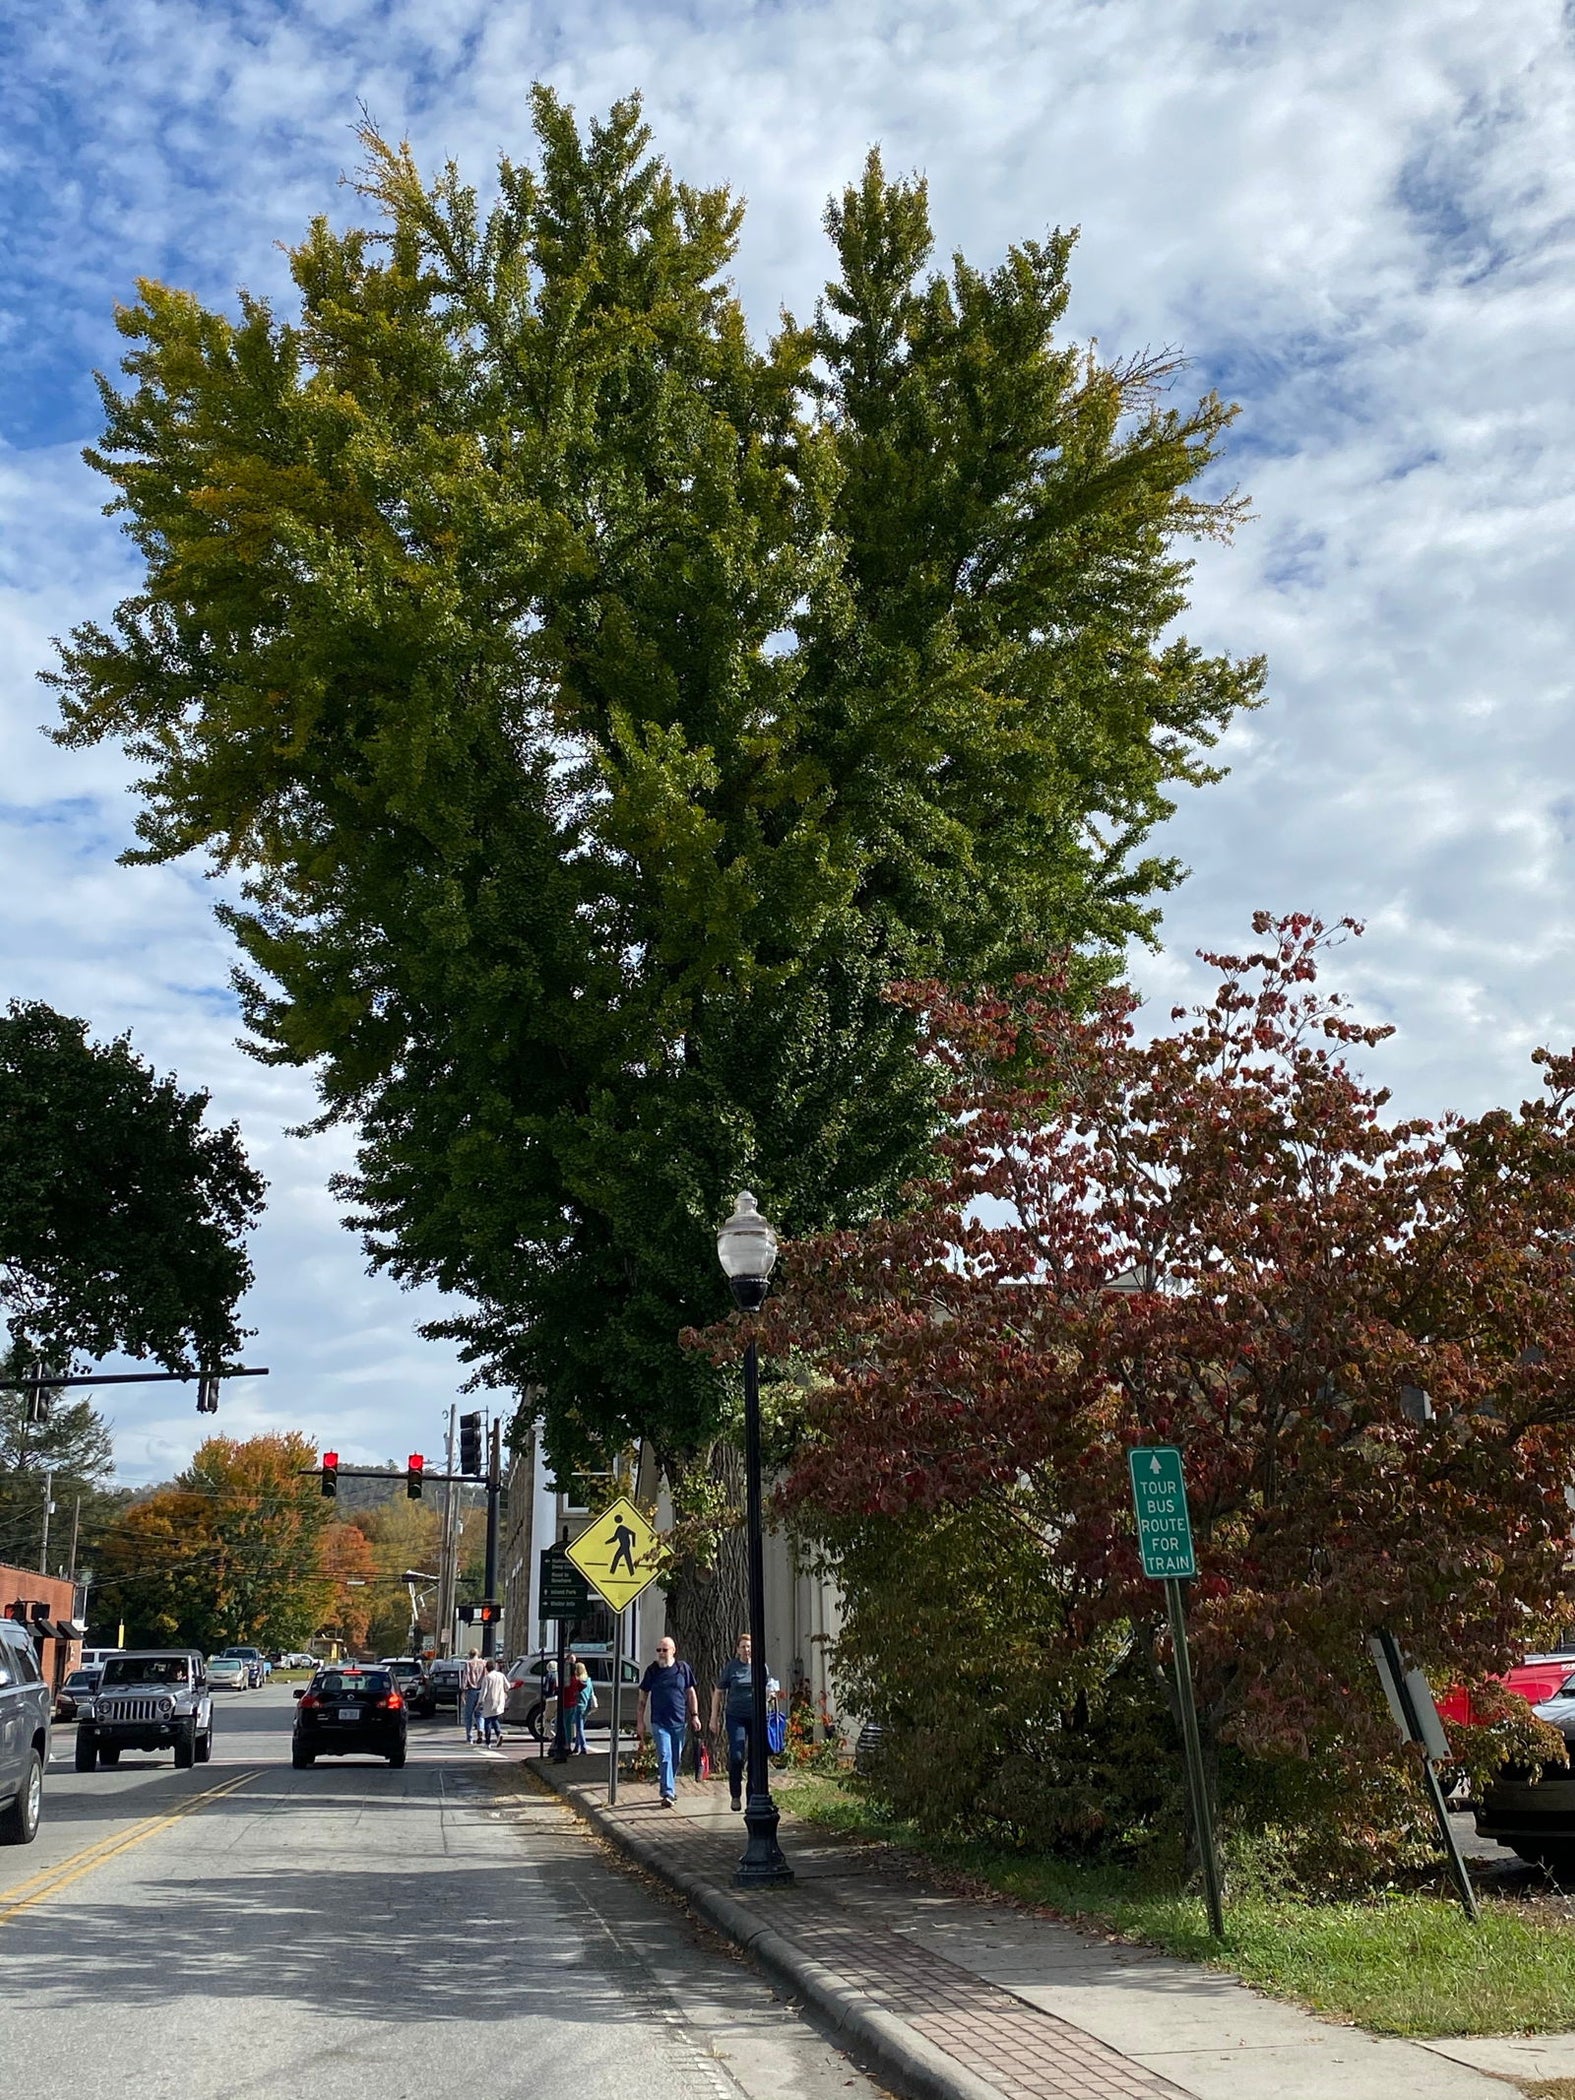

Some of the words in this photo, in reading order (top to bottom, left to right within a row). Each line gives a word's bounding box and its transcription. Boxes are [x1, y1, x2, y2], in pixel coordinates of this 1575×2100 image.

[1140, 1481, 1177, 1495] TOUR
[1147, 1500, 1175, 1513] BUS
[1141, 1518, 1186, 1532] ROUTE
[1151, 1537, 1179, 1551] FOR
[1147, 1556, 1190, 1570] TRAIN
